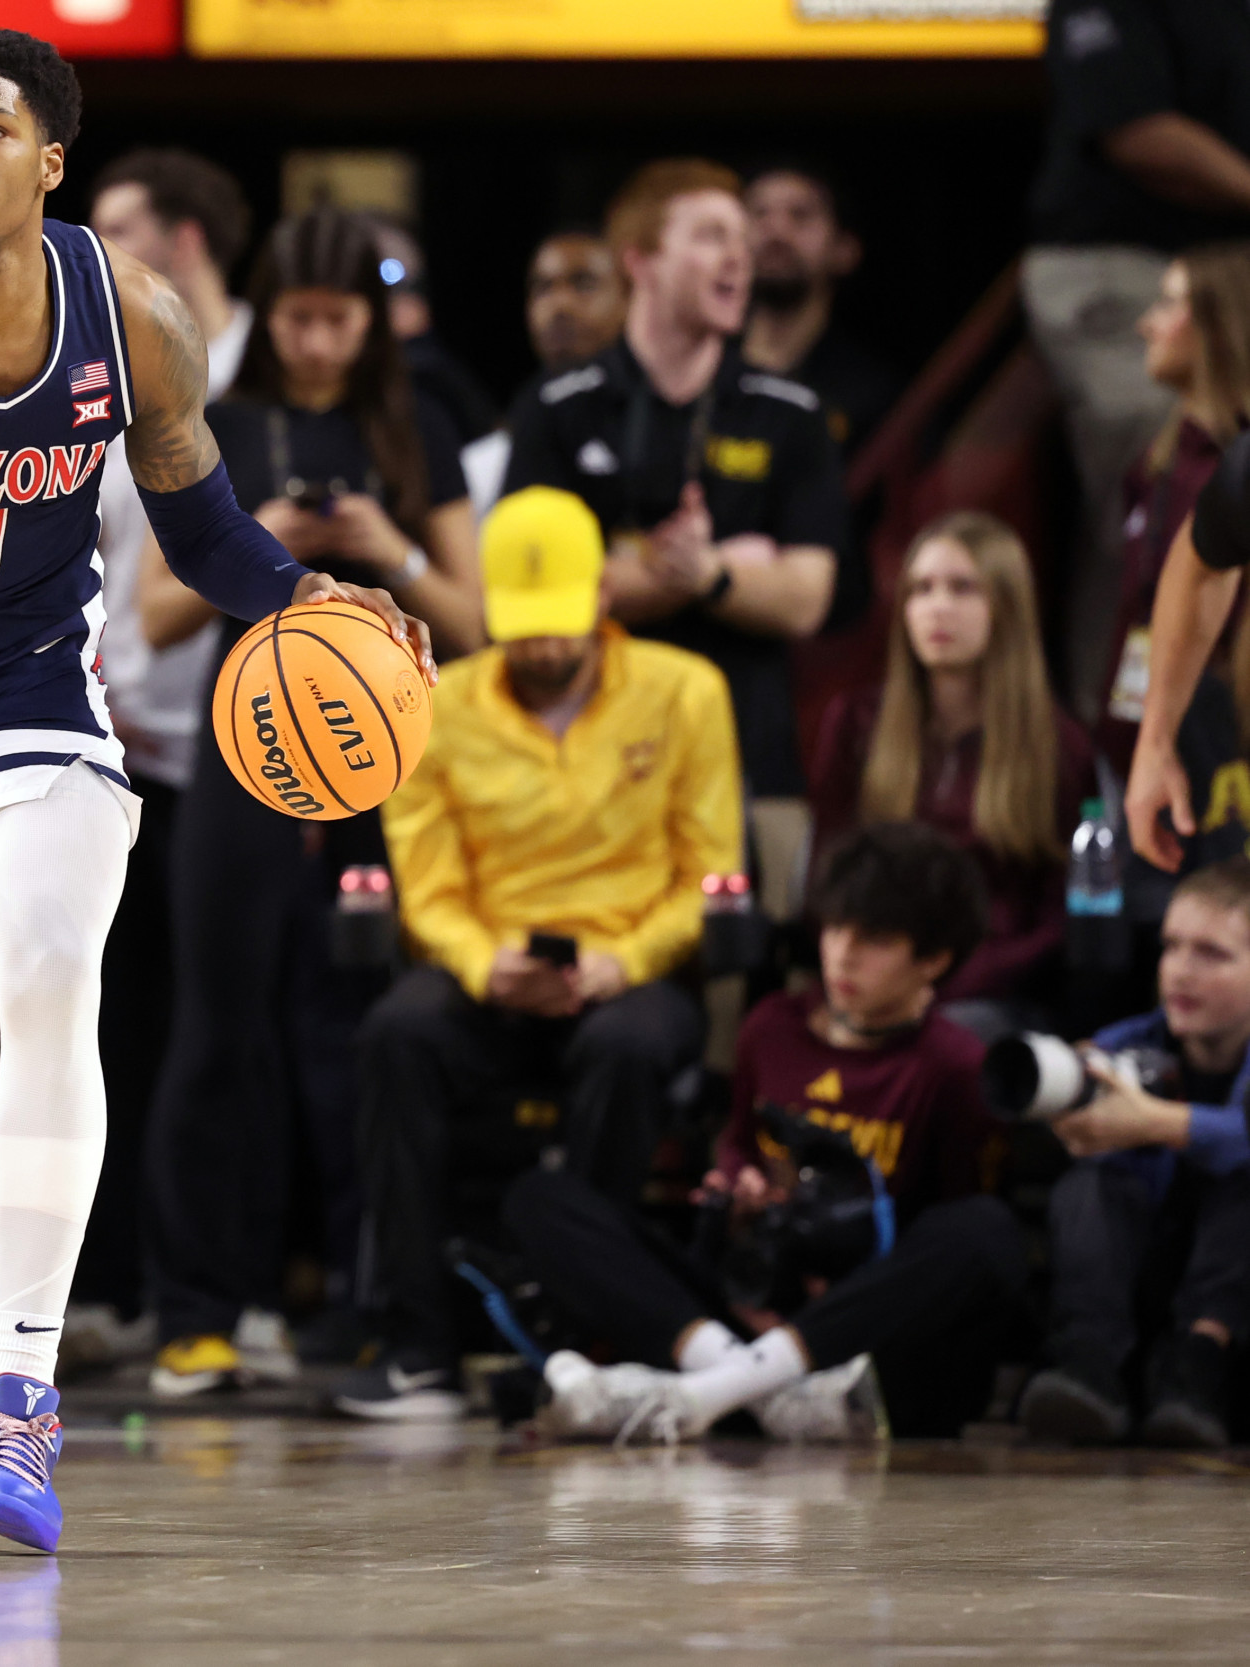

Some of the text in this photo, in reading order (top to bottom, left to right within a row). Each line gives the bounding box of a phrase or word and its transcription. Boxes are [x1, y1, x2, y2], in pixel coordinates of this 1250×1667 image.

[75, 397, 110, 425] XII
[303, 676, 324, 700] NXT
[251, 691, 325, 815] Wilson
